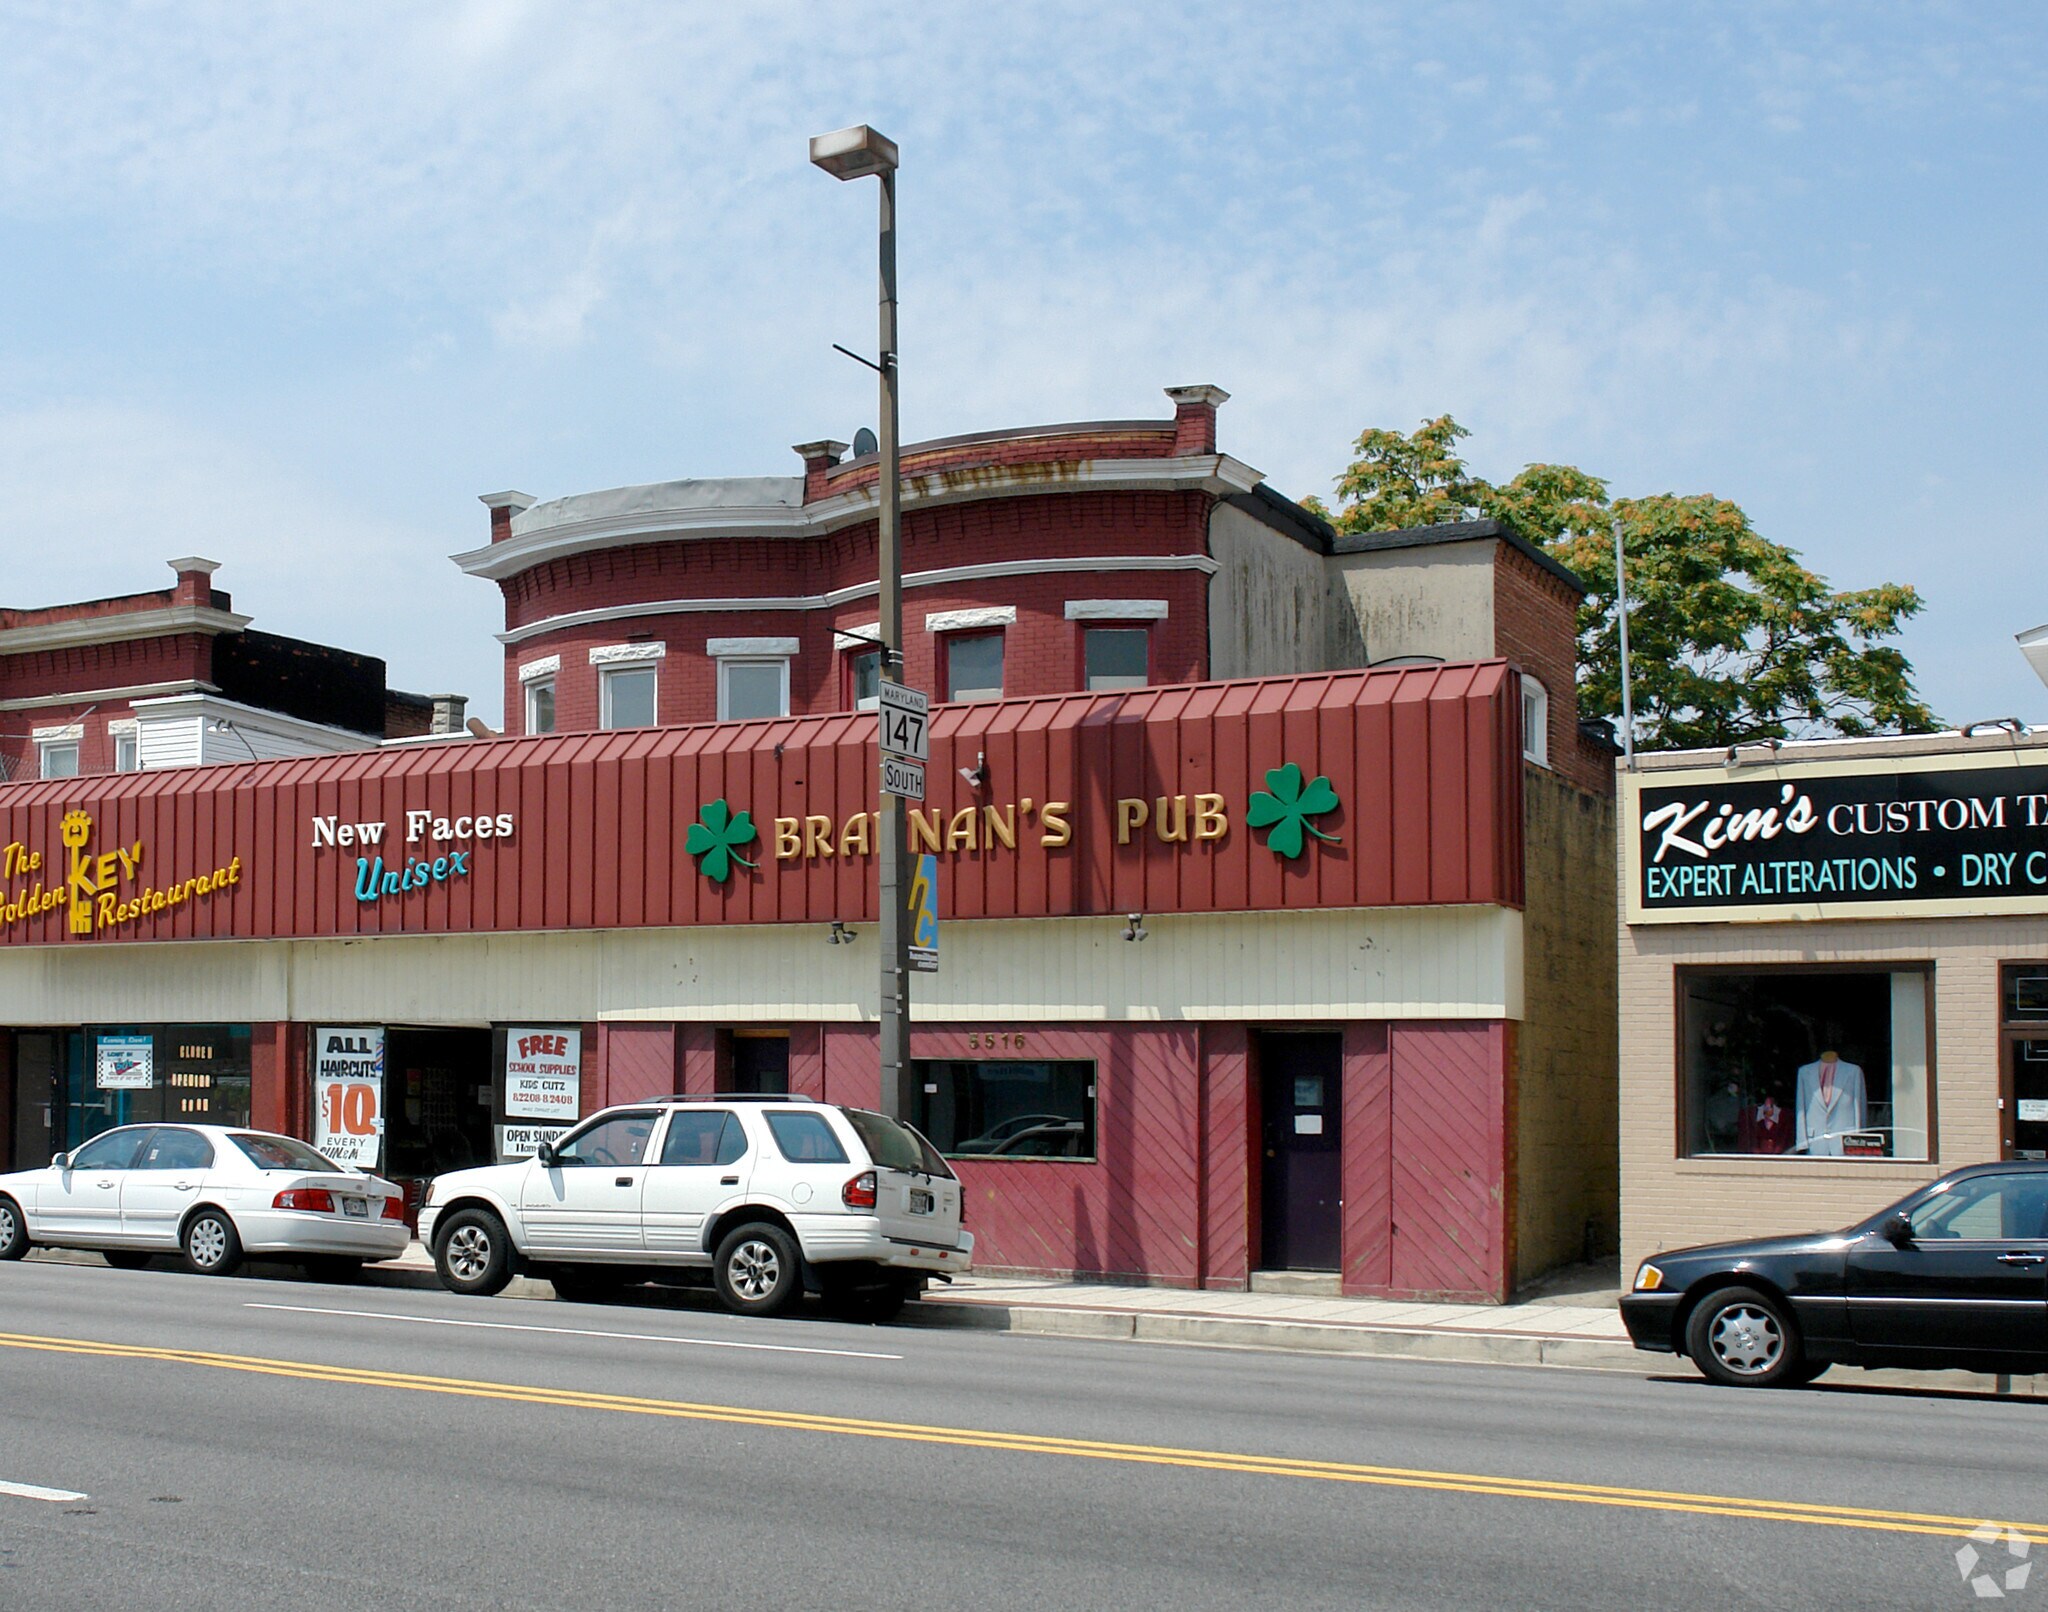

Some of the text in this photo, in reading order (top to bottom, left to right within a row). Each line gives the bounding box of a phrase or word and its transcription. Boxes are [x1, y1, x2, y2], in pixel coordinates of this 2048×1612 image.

[884, 687, 924, 709] MARYLAND
[885, 710, 923, 753] 147
[887, 764, 922, 793] SOUTH
[311, 810, 514, 848] New Faces
[774, 793, 1228, 858] BRANAN'S PUB
[1643, 784, 2048, 863] Kim's CUSTOM T
[4, 841, 41, 880] The
[355, 851, 470, 901] Unisex
[1647, 864, 1737, 899] EXPERT
[1740, 856, 1918, 895] ALTERATIONS
[1961, 851, 2018, 887] DRY
[98, 857, 241, 928] Restaurant
[326, 1036, 372, 1054] ALL
[517, 1035, 568, 1059] FREE
[968, 1032, 1025, 1049] 5516
[320, 1059, 377, 1078] HAIRCUTS
[508, 1062, 577, 1075] SCHOOL SUPPLIES
[519, 1079, 565, 1091] KIDS CUTZ
[327, 1137, 366, 1147] EVERY
[507, 1129, 531, 1143] OPEN
